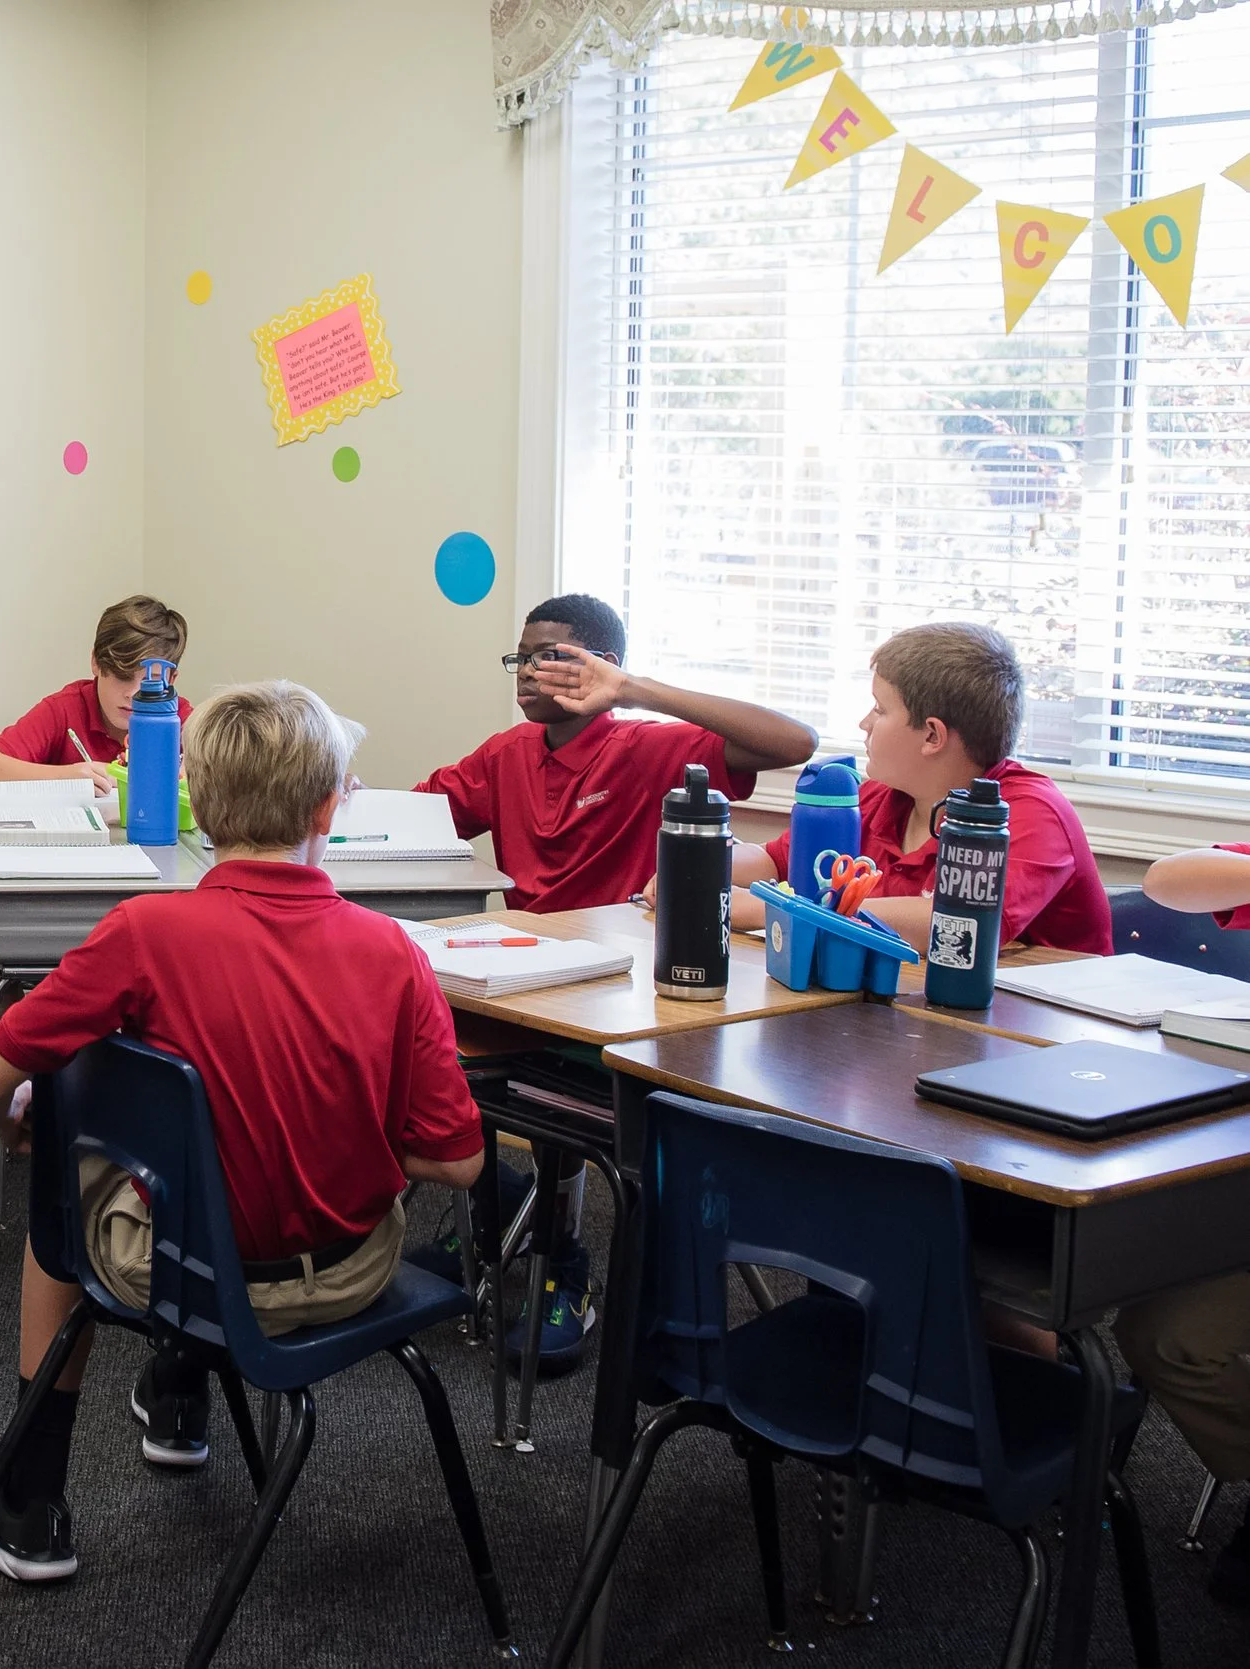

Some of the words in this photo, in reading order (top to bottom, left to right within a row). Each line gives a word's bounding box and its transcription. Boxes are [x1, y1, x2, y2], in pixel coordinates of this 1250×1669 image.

[941, 844, 945, 858] I
[947, 846, 983, 866] NEED
[987, 851, 1004, 867] MY
[939, 865, 998, 901] SPACE.
[674, 968, 702, 980] YETI
